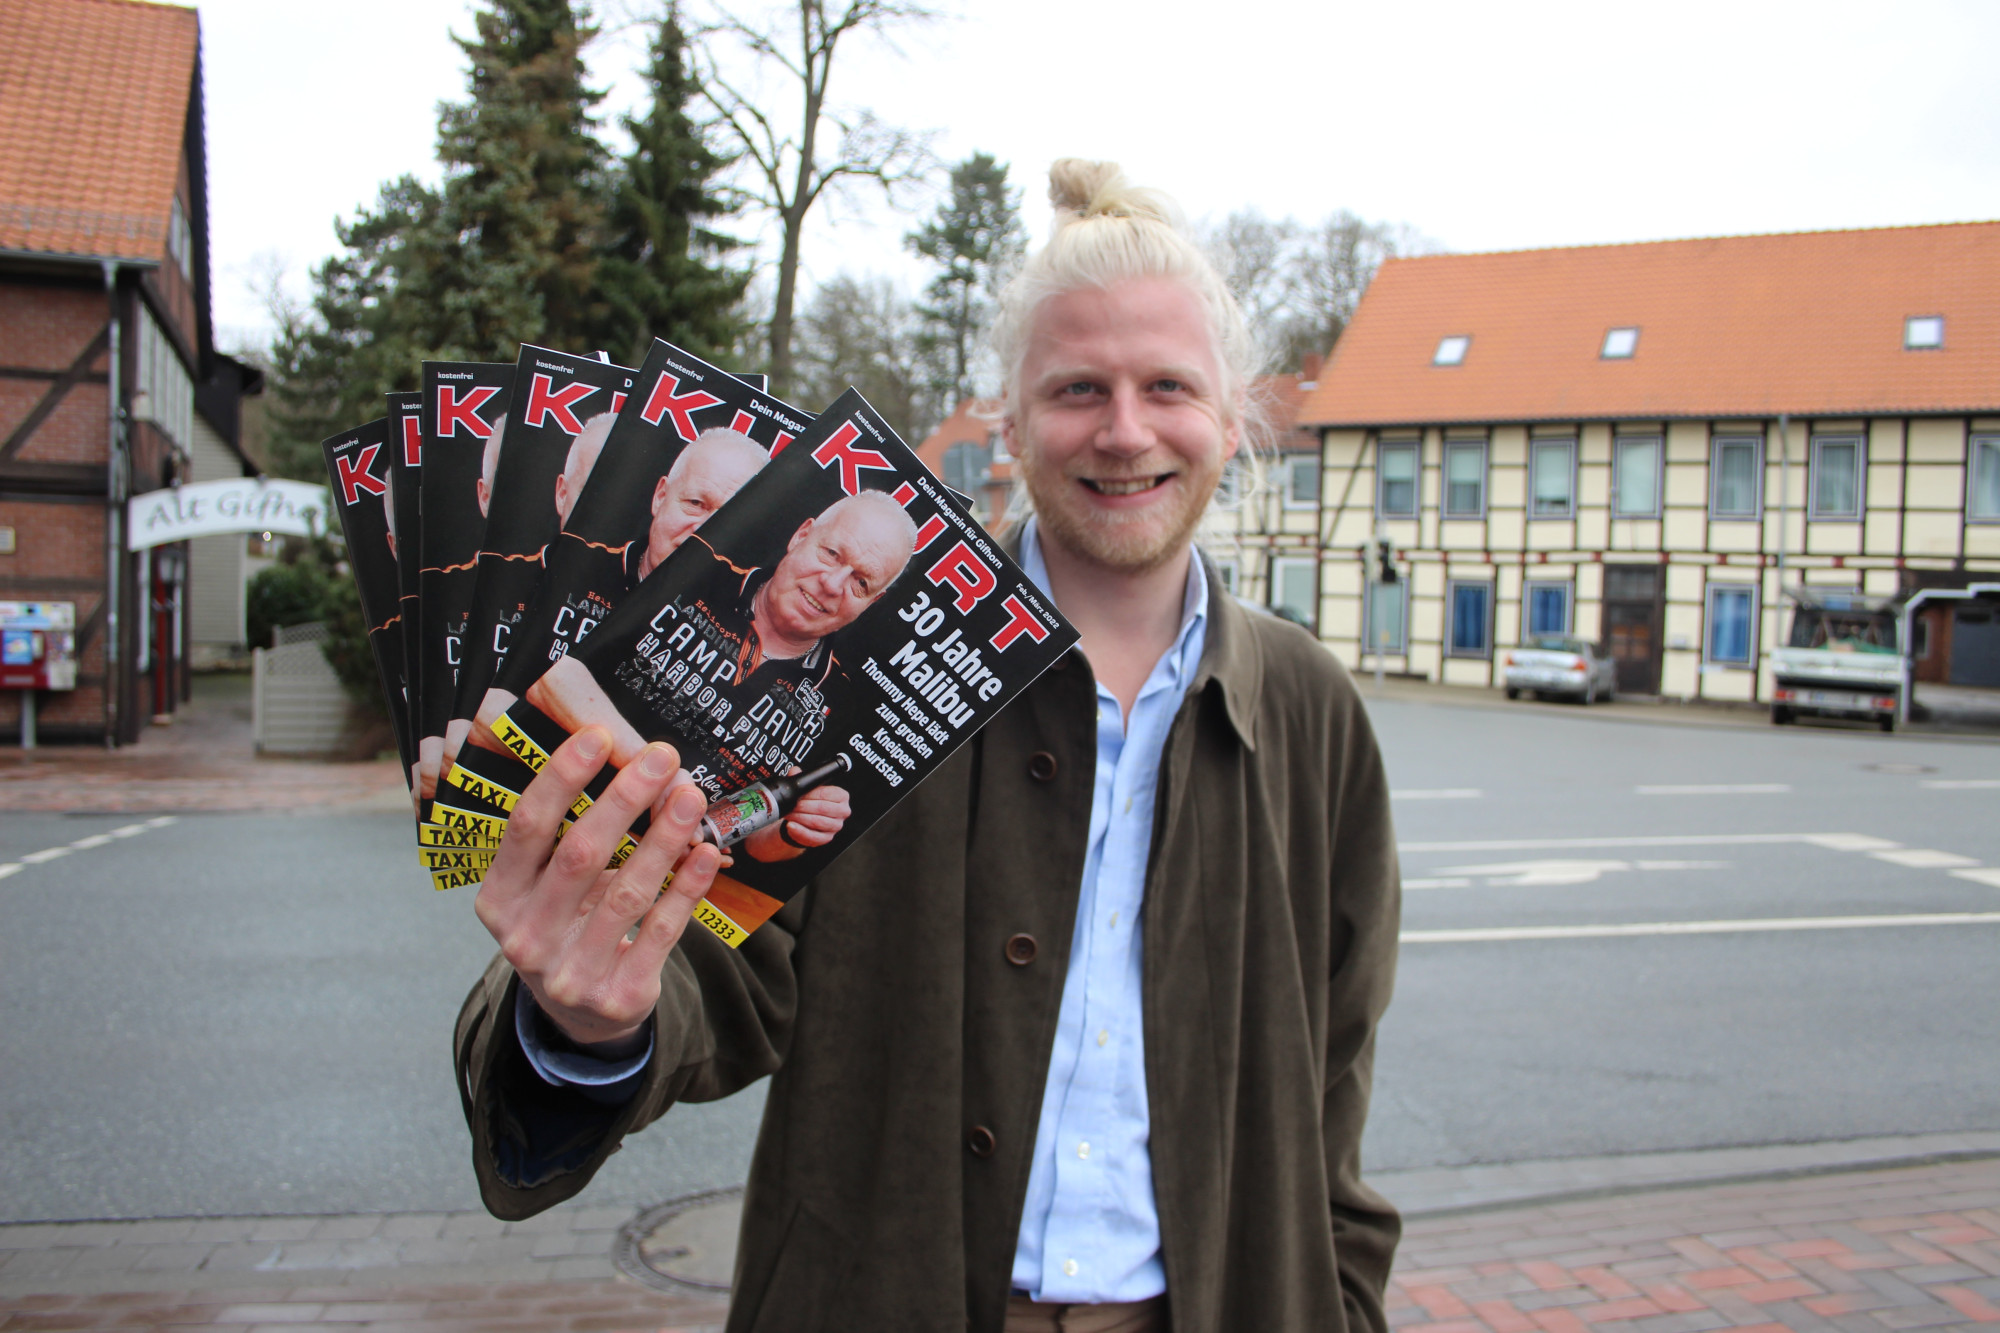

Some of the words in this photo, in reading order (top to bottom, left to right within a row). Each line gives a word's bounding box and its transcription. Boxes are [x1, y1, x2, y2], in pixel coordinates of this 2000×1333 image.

[437, 372, 474, 380] kostenfrei
[536, 359, 574, 374] kostenfrei
[666, 358, 704, 382] kostenfrei
[750, 399, 773, 416] Dein
[854, 410, 887, 444] kostenfrei
[332, 437, 359, 453] kostenfrei
[146, 494, 208, 530] Alt
[917, 476, 938, 498] Dein
[934, 494, 966, 532] Magazin
[964, 527, 978, 541] für
[975, 538, 1003, 570] Gifhorn
[810, 419, 1050, 654] KURT
[567, 592, 610, 620] LAN
[694, 599, 742, 644] Helicopte
[1016, 582, 1044, 614] Feb./März
[1042, 611, 1060, 630] 2022
[897, 590, 945, 637] 30
[931, 628, 1003, 702] Jahre
[636, 632, 732, 722] HARBOR
[732, 715, 794, 777] PILOTS
[650, 604, 737, 684] CAMP
[748, 693, 814, 763] DAVID
[861, 656, 906, 704] Thommy
[901, 697, 930, 727] Hepe
[925, 720, 950, 746] lädt
[888, 639, 976, 730] Malibu
[712, 724, 736, 742] BY
[734, 744, 759, 766] AIR
[872, 727, 916, 771] Kneipen-
[875, 703, 900, 728] zum
[894, 723, 934, 760] großen
[848, 733, 904, 788] Geburtstag
[480, 853, 496, 868] H
[486, 835, 502, 848] H
[698, 907, 736, 941] 12333
